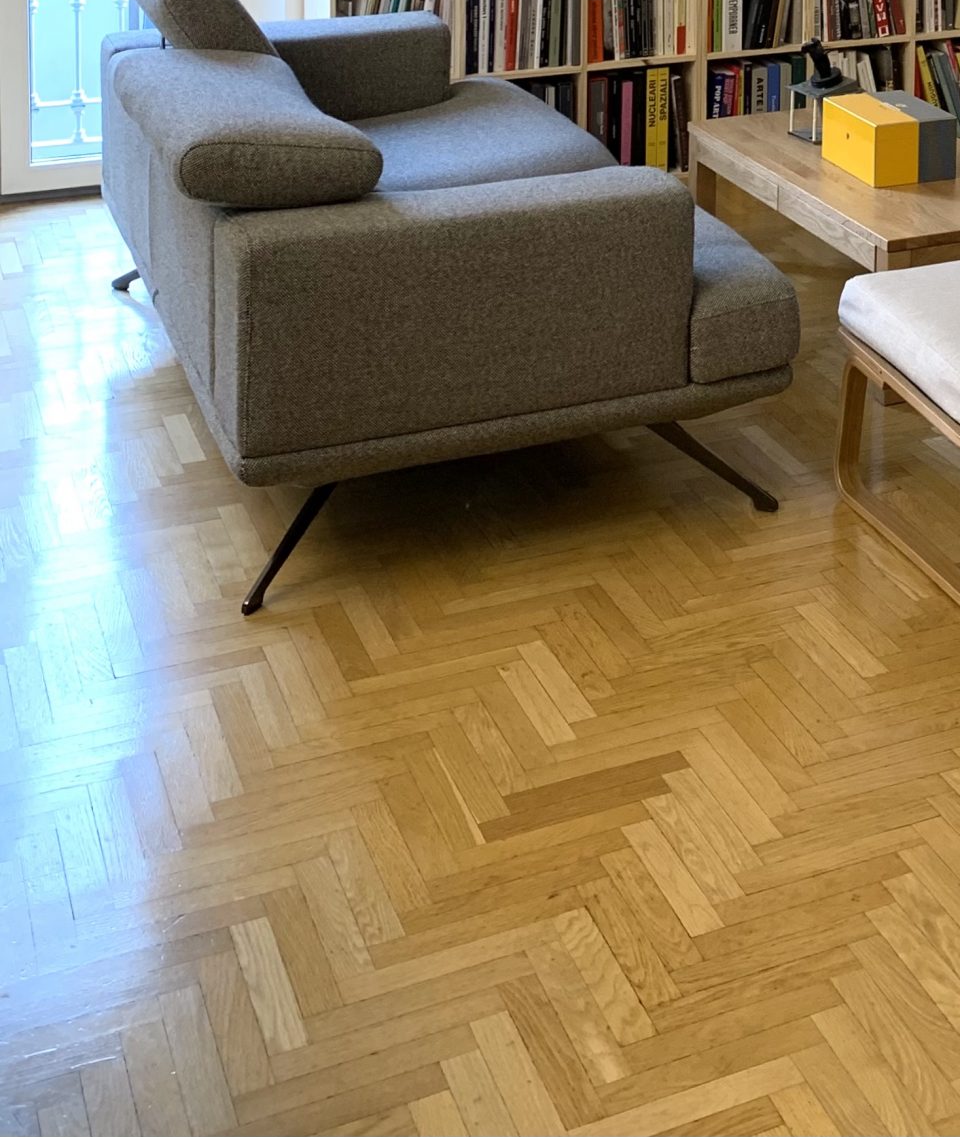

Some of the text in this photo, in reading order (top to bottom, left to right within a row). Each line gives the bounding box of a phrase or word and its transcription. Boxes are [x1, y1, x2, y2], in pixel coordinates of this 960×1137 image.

[648, 80, 657, 128] NUCLEARI
[659, 78, 668, 121] SPAZIALI
[714, 85, 722, 102] POP
[756, 77, 765, 106] ARTE
